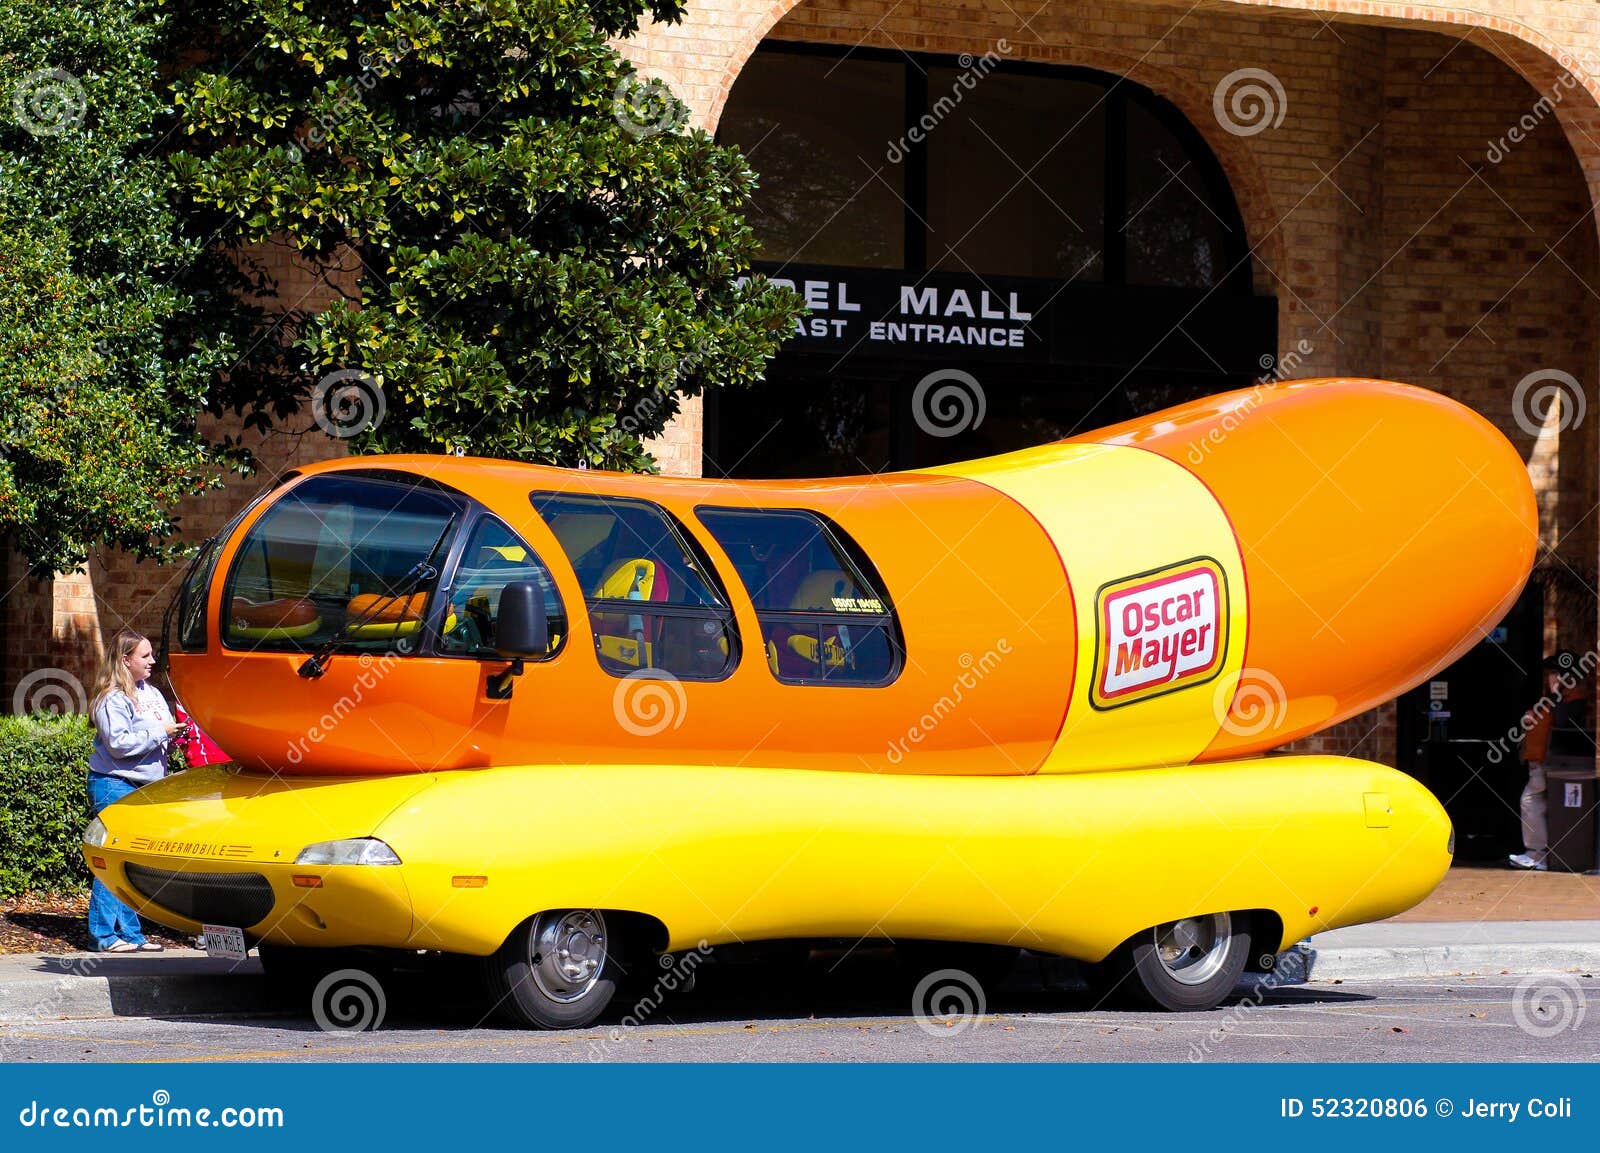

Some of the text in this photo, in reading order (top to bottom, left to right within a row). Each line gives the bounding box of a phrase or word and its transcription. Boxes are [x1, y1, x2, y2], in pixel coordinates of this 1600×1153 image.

[900, 285, 1032, 321] MALL
[869, 321, 1025, 347] ENTRANCE
[1122, 588, 1205, 637] Oscar
[1114, 622, 1211, 681] Mayer
[147, 840, 227, 857] WIENERMOBILE
